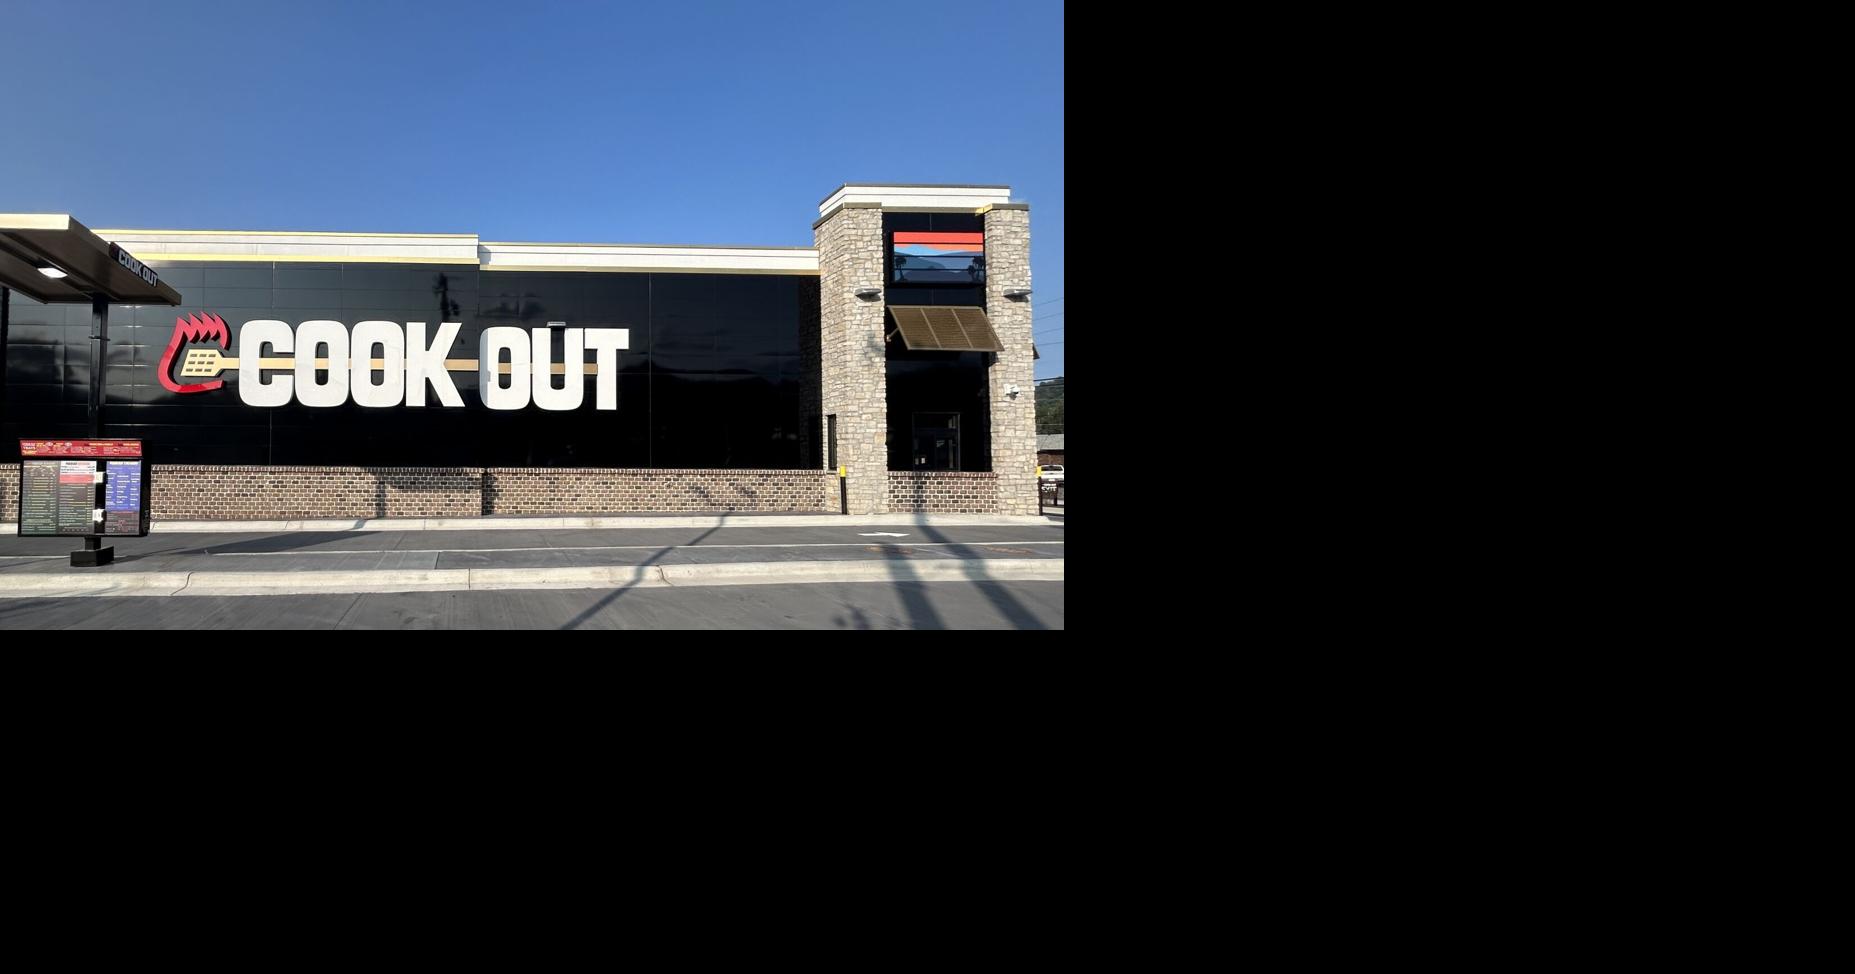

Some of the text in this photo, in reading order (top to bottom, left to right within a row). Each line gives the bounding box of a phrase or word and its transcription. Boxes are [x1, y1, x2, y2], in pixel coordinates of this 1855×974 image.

[118, 249, 158, 287] COOK OUT
[238, 319, 630, 411] COOK OUT
